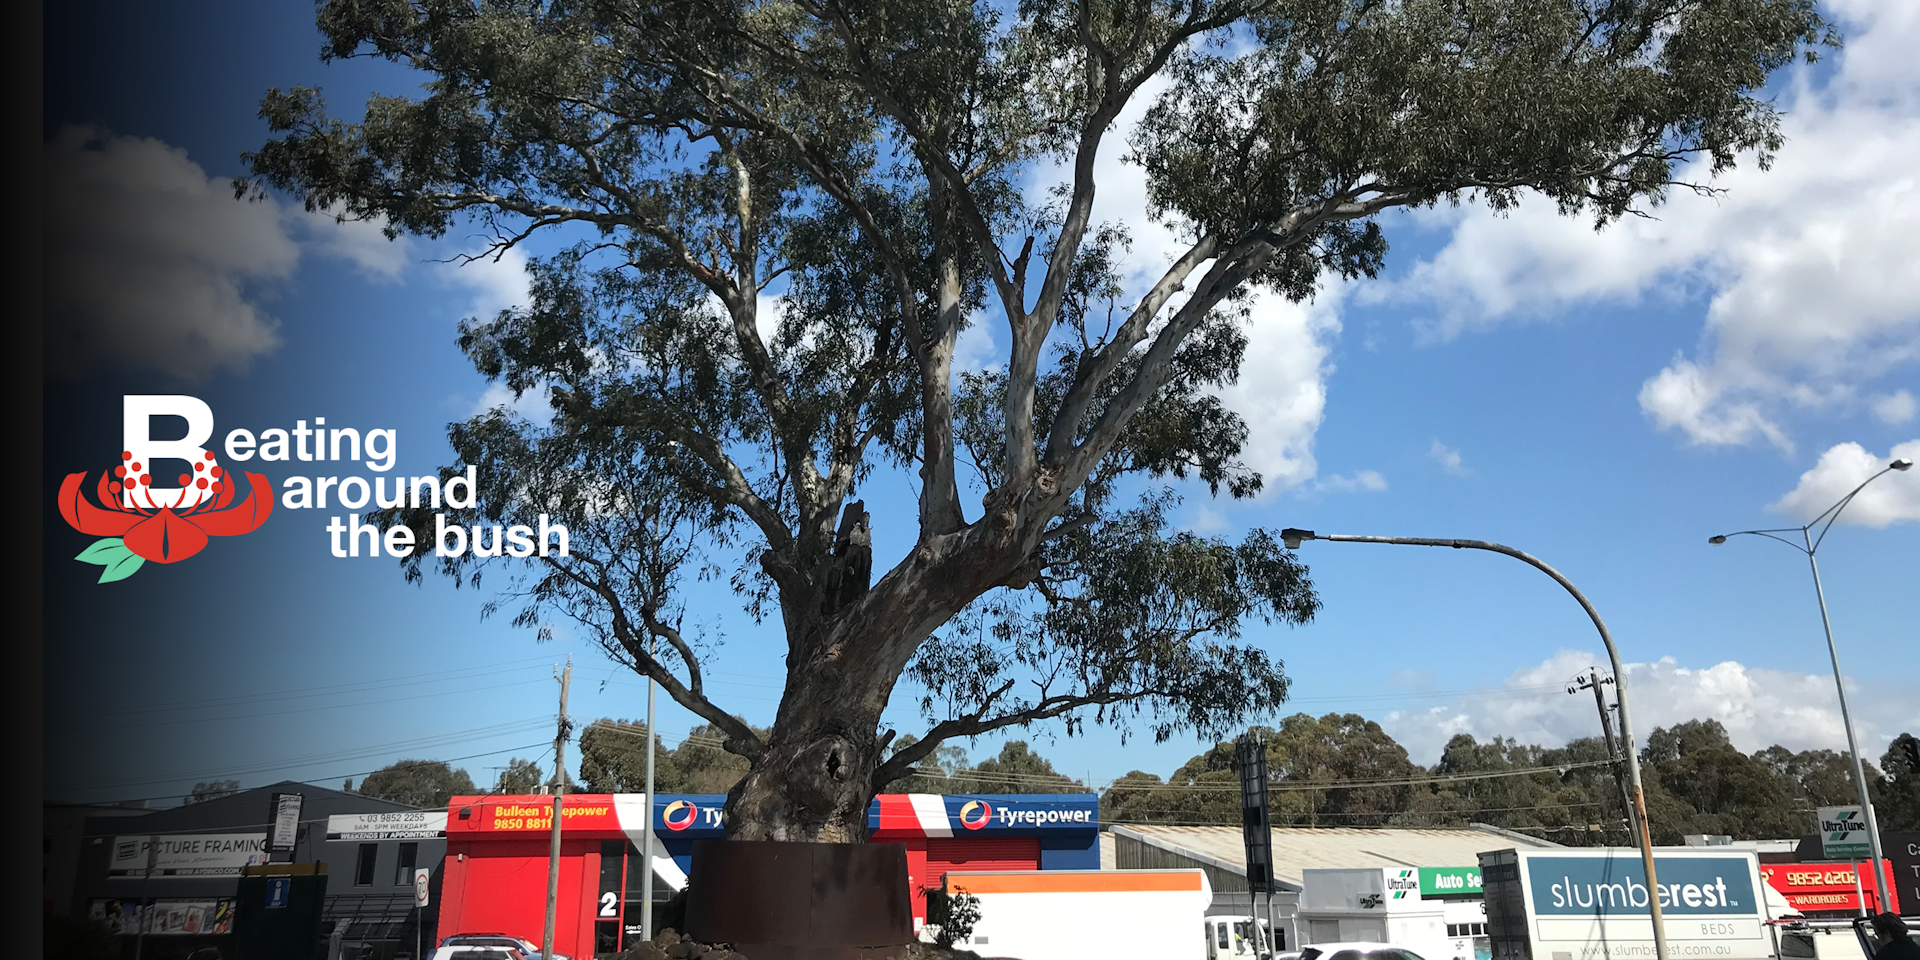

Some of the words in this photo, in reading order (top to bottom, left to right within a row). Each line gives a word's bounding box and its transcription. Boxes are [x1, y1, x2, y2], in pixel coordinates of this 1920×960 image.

[367, 814, 378, 823] 03
[380, 813, 401, 822] 9852
[404, 813, 425, 822] 2255
[495, 806, 539, 817] Bulleen
[544, 806, 608, 818] Tyepower
[703, 807, 723, 828] Ty
[997, 807, 1091, 828] Tyrepower
[494, 819, 523, 829] 9850
[526, 818, 553, 829] 8811
[1822, 820, 1865, 832] UltraTune
[140, 840, 201, 855] PCTURE
[1387, 878, 1418, 890] UltraTune
[1435, 873, 1463, 889] Auto
[1467, 872, 1483, 888] Se
[1786, 872, 1823, 885] 9852
[1824, 871, 1856, 885] 4202
[418, 881, 426, 894] 70
[1551, 876, 1727, 908] slumberest
[600, 892, 617, 917] 2
[1701, 923, 1735, 935] BEDS
[1579, 944, 1731, 957] www.slumbeest.com.au
